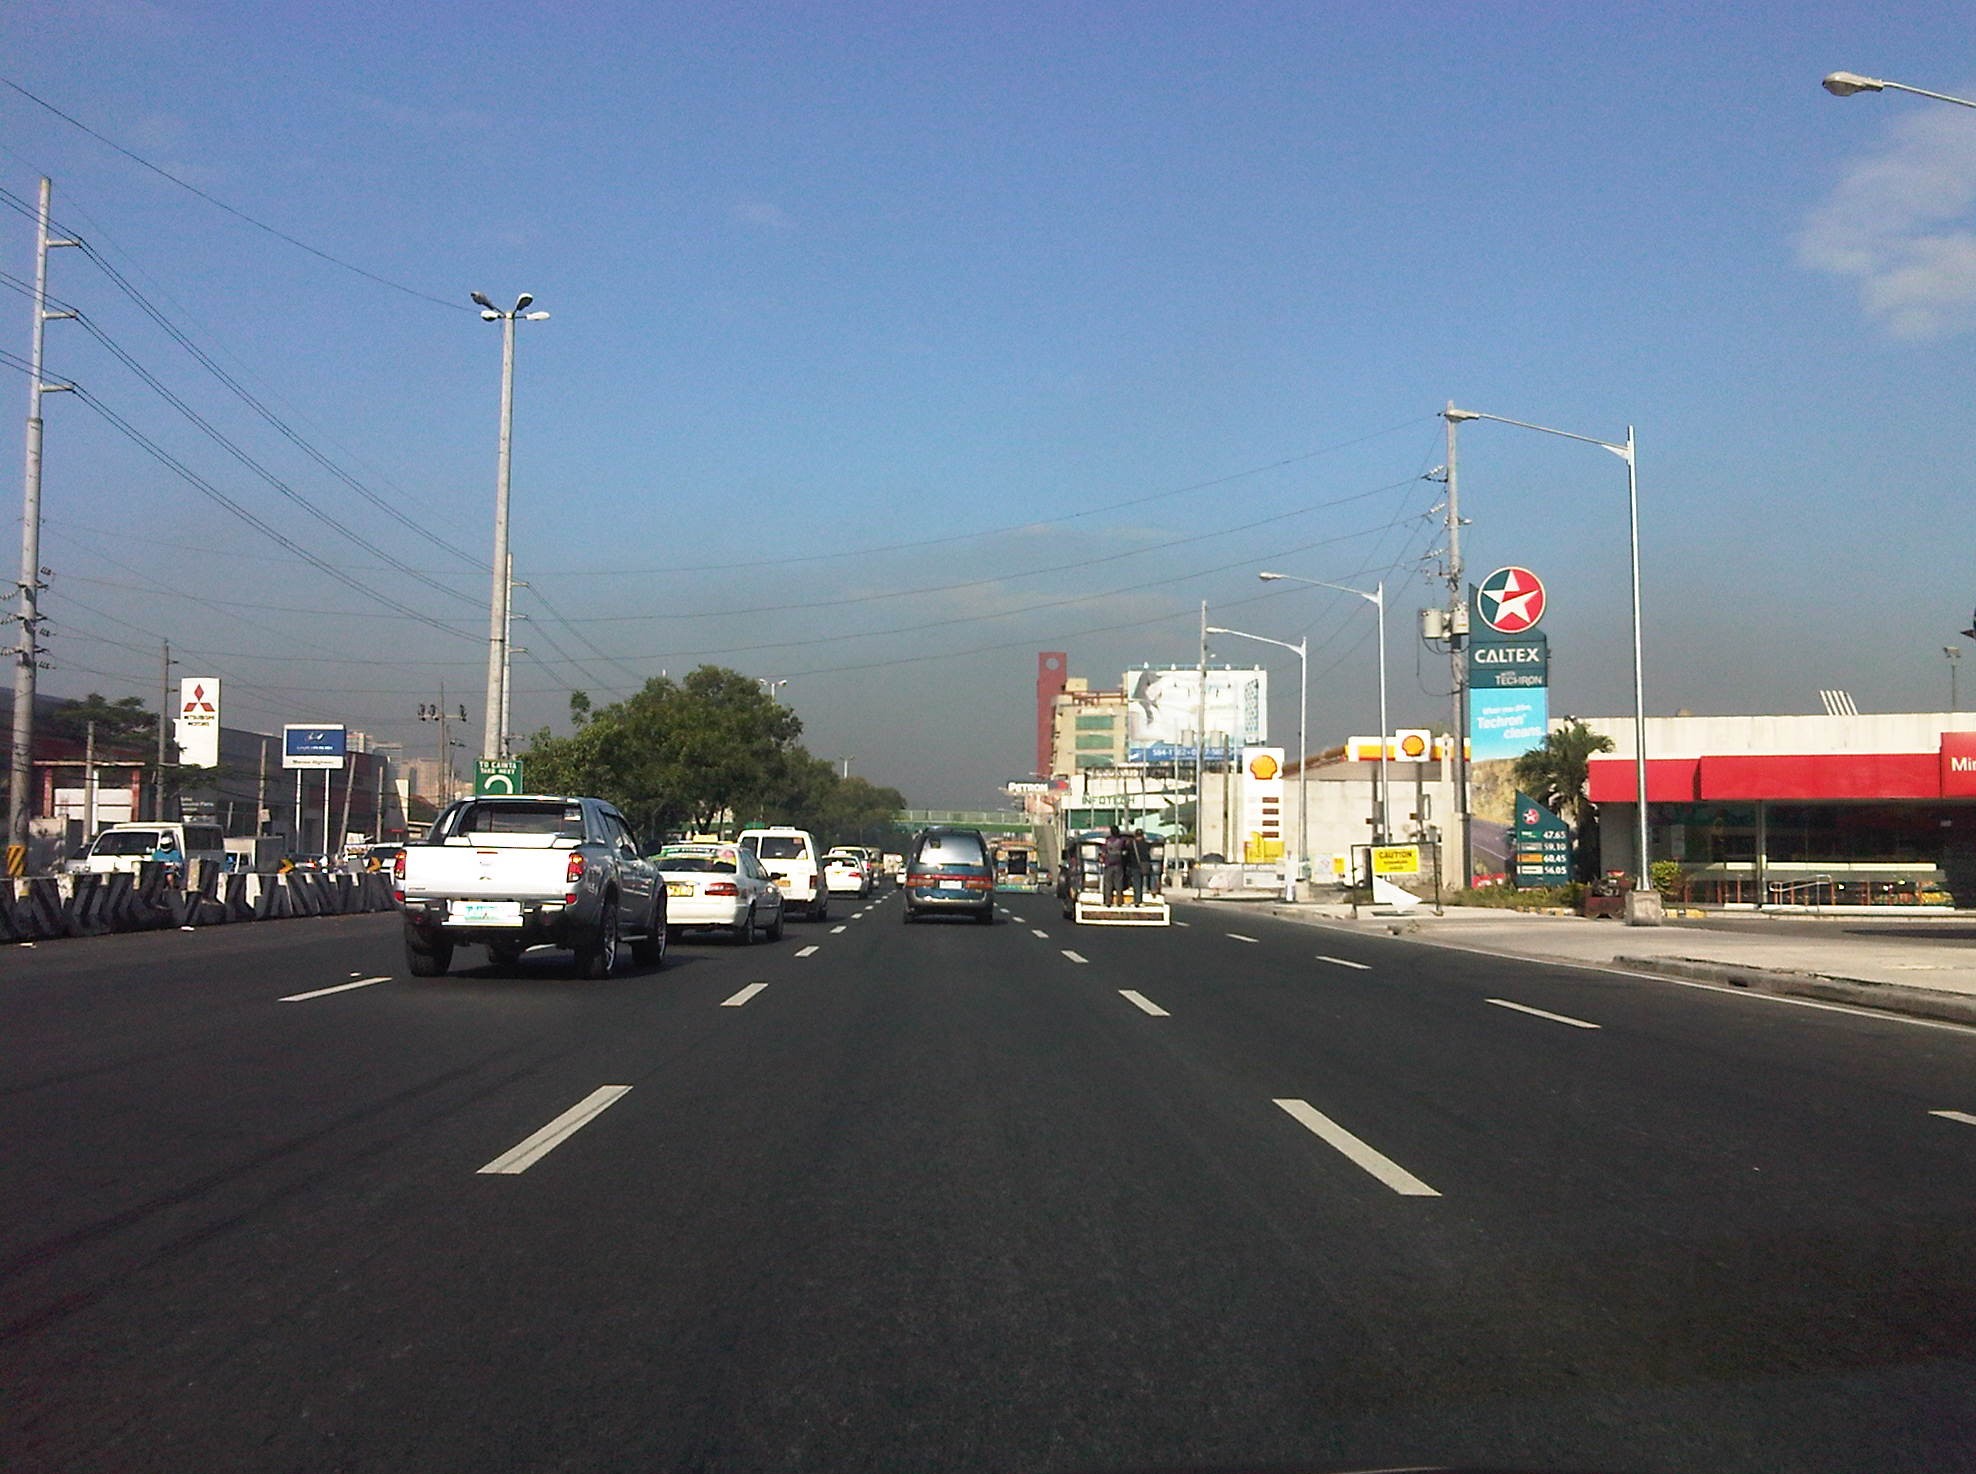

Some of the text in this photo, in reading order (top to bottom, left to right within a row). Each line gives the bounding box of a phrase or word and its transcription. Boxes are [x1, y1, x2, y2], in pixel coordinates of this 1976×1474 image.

[1474, 648, 1539, 663] CALTEX
[1495, 675, 1542, 686] TECHRON
[1008, 782, 1048, 792] PETRON
[1543, 830, 1567, 839] 47.65
[1543, 842, 1567, 851] 59.10
[1378, 851, 1413, 859] CAUTION
[1543, 866, 1568, 875] 56.05
